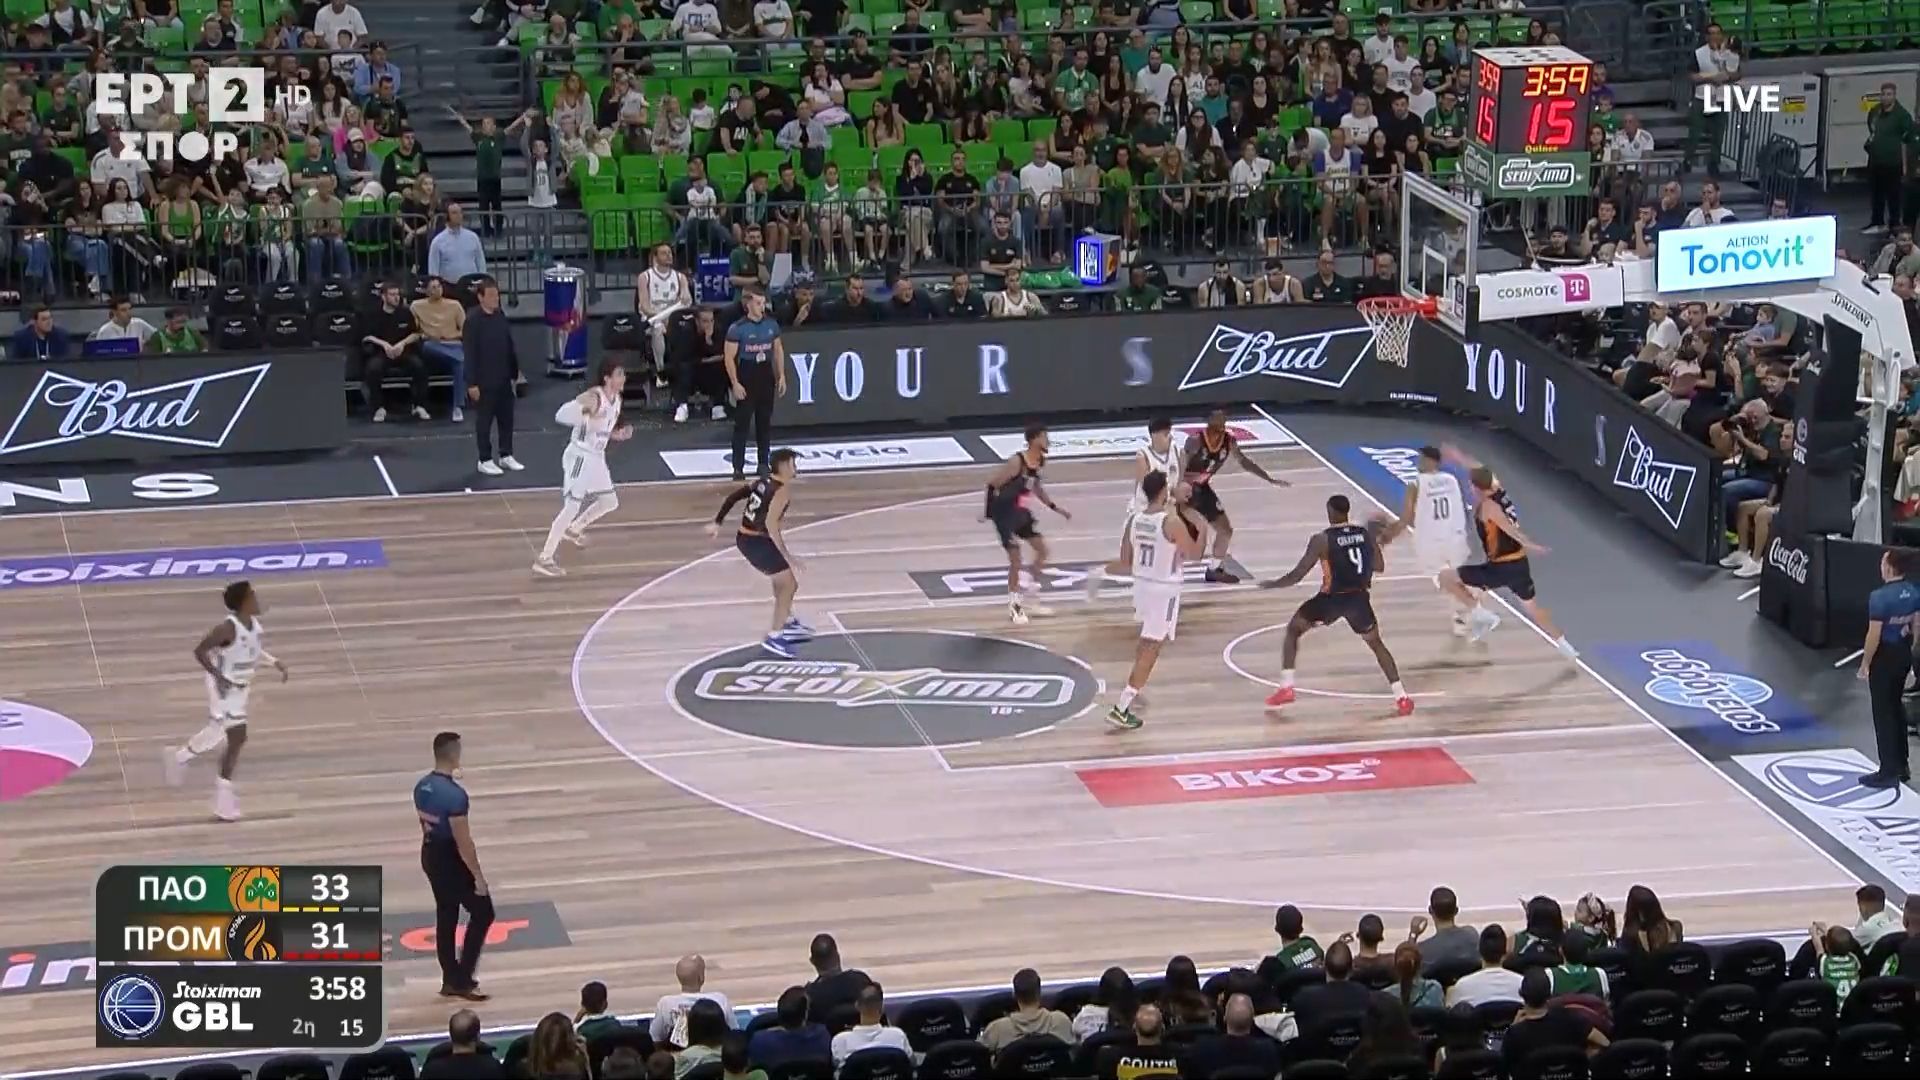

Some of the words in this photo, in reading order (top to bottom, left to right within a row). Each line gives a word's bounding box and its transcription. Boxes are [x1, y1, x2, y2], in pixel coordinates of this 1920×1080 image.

[1524, 66, 1589, 96] 3:59
[1529, 101, 1576, 145] 15
[1681, 235, 1804, 276] Tonovit
[1726, 235, 1769, 249] ALTION
[1830, 293, 1873, 329] SPALDING
[1216, 330, 1331, 377] Bud
[44, 379, 202, 437] Bud
[1628, 437, 1675, 503] Bud
[1432, 497, 1450, 521] 10
[1348, 548, 1363, 574] 4
[1171, 763, 1377, 791] ΒΙΚΟΣ
